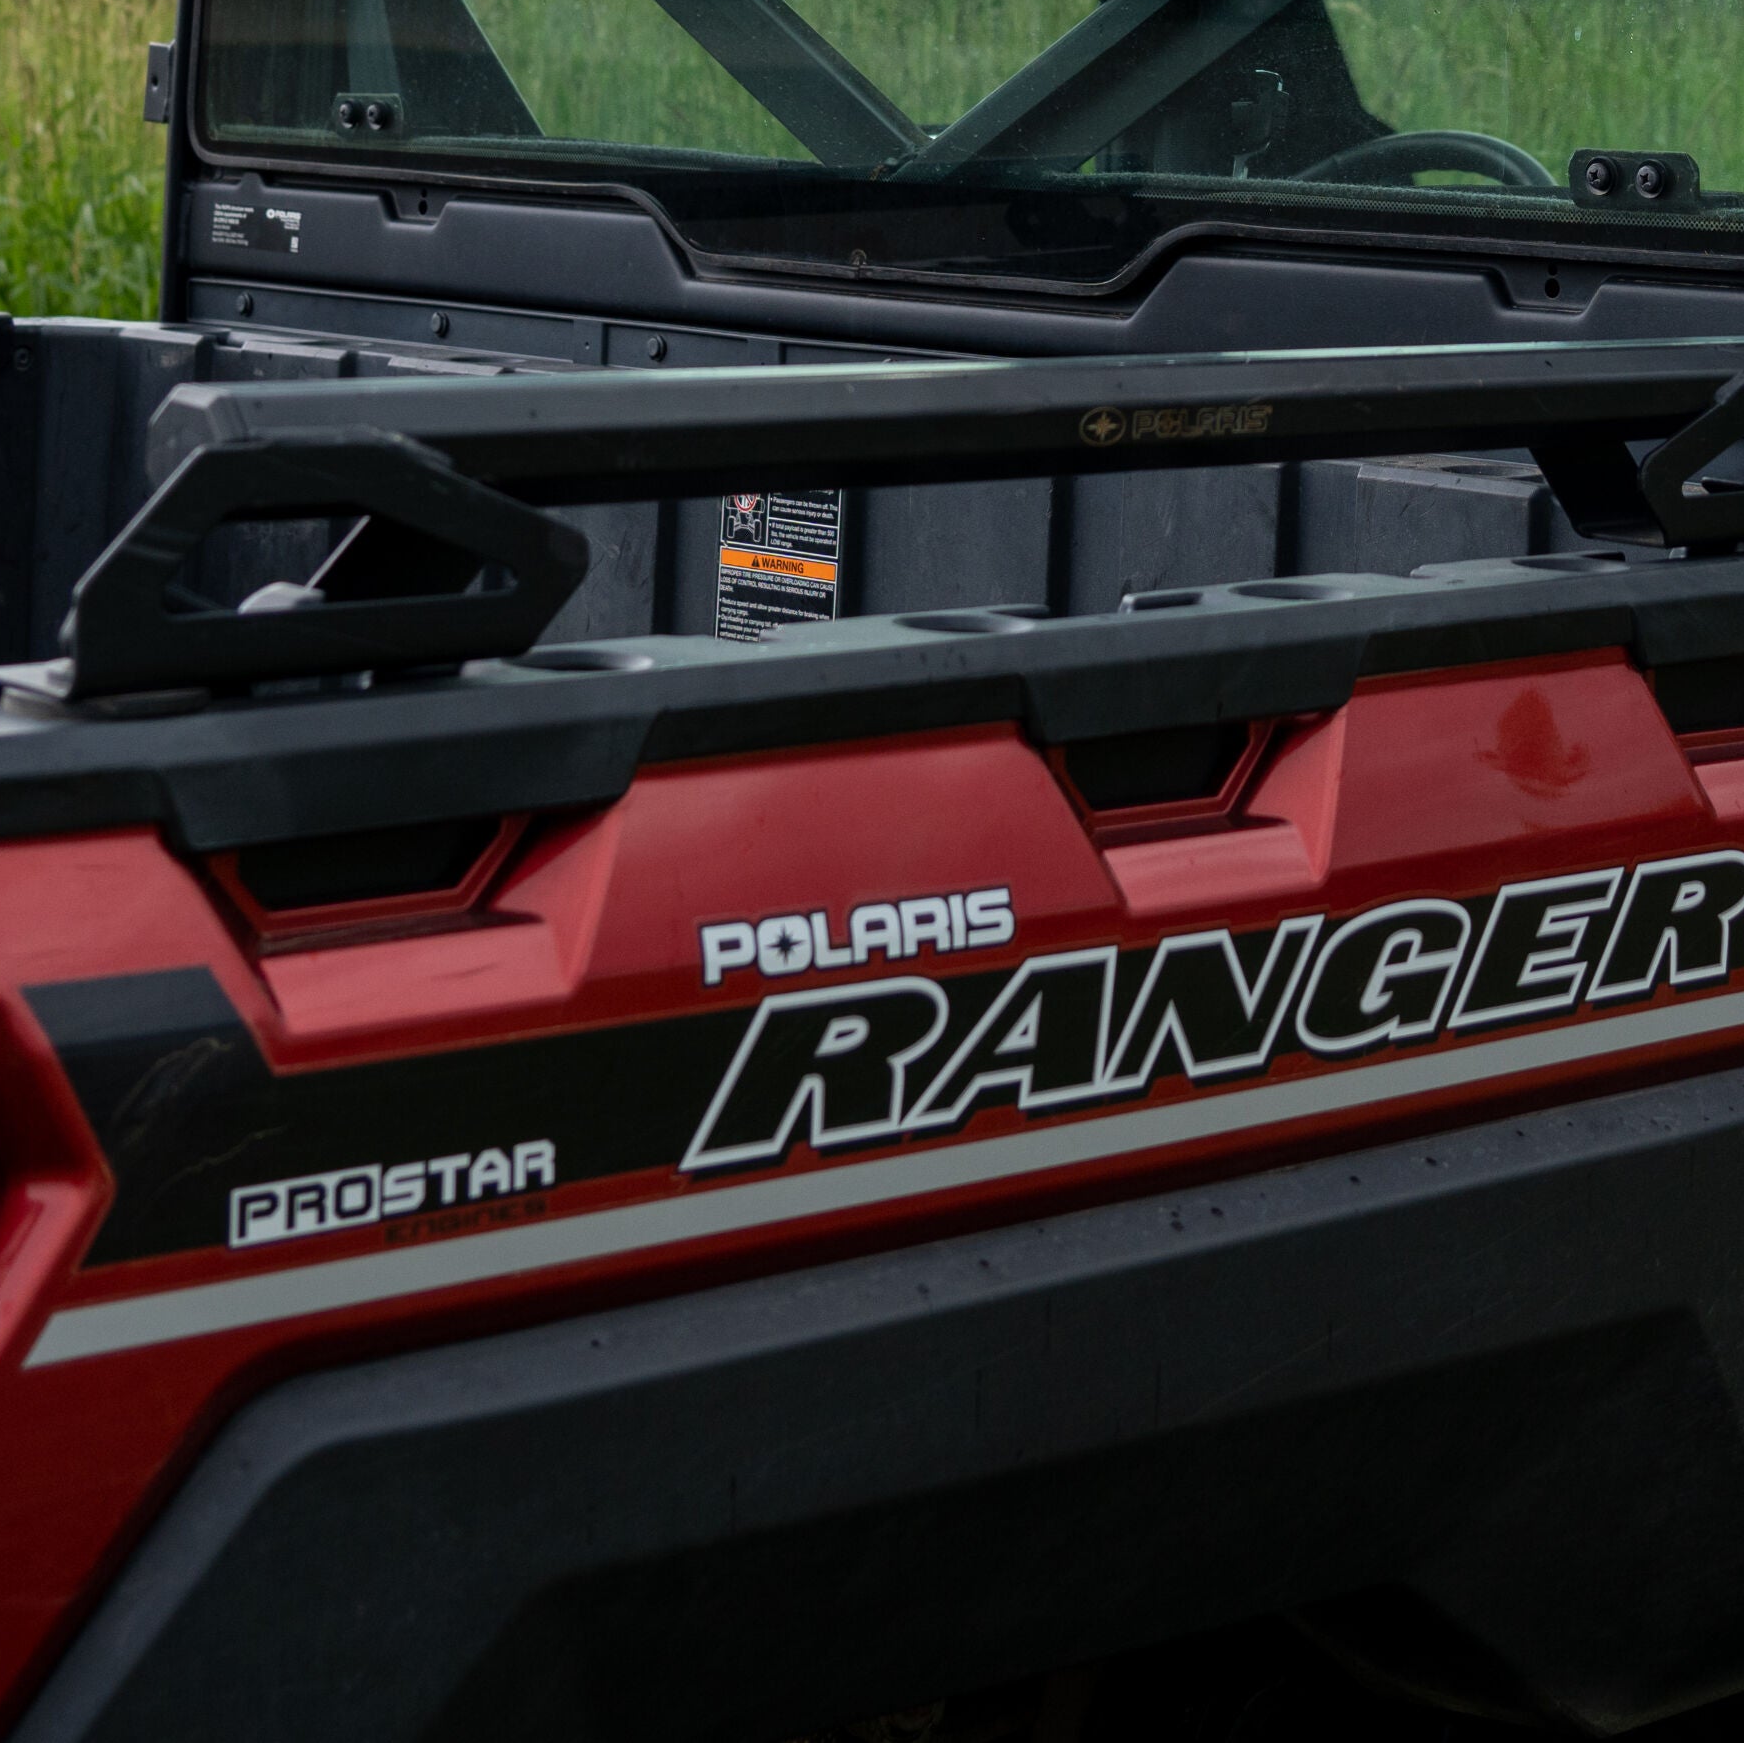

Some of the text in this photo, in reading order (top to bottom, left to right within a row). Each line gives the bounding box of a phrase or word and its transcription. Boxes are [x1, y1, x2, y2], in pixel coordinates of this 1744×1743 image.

[1131, 404, 1273, 441] POLARIS
[761, 557, 804, 574] WARNING
[700, 886, 1016, 986] POLARIS
[233, 1137, 557, 1244] PROSTAR
